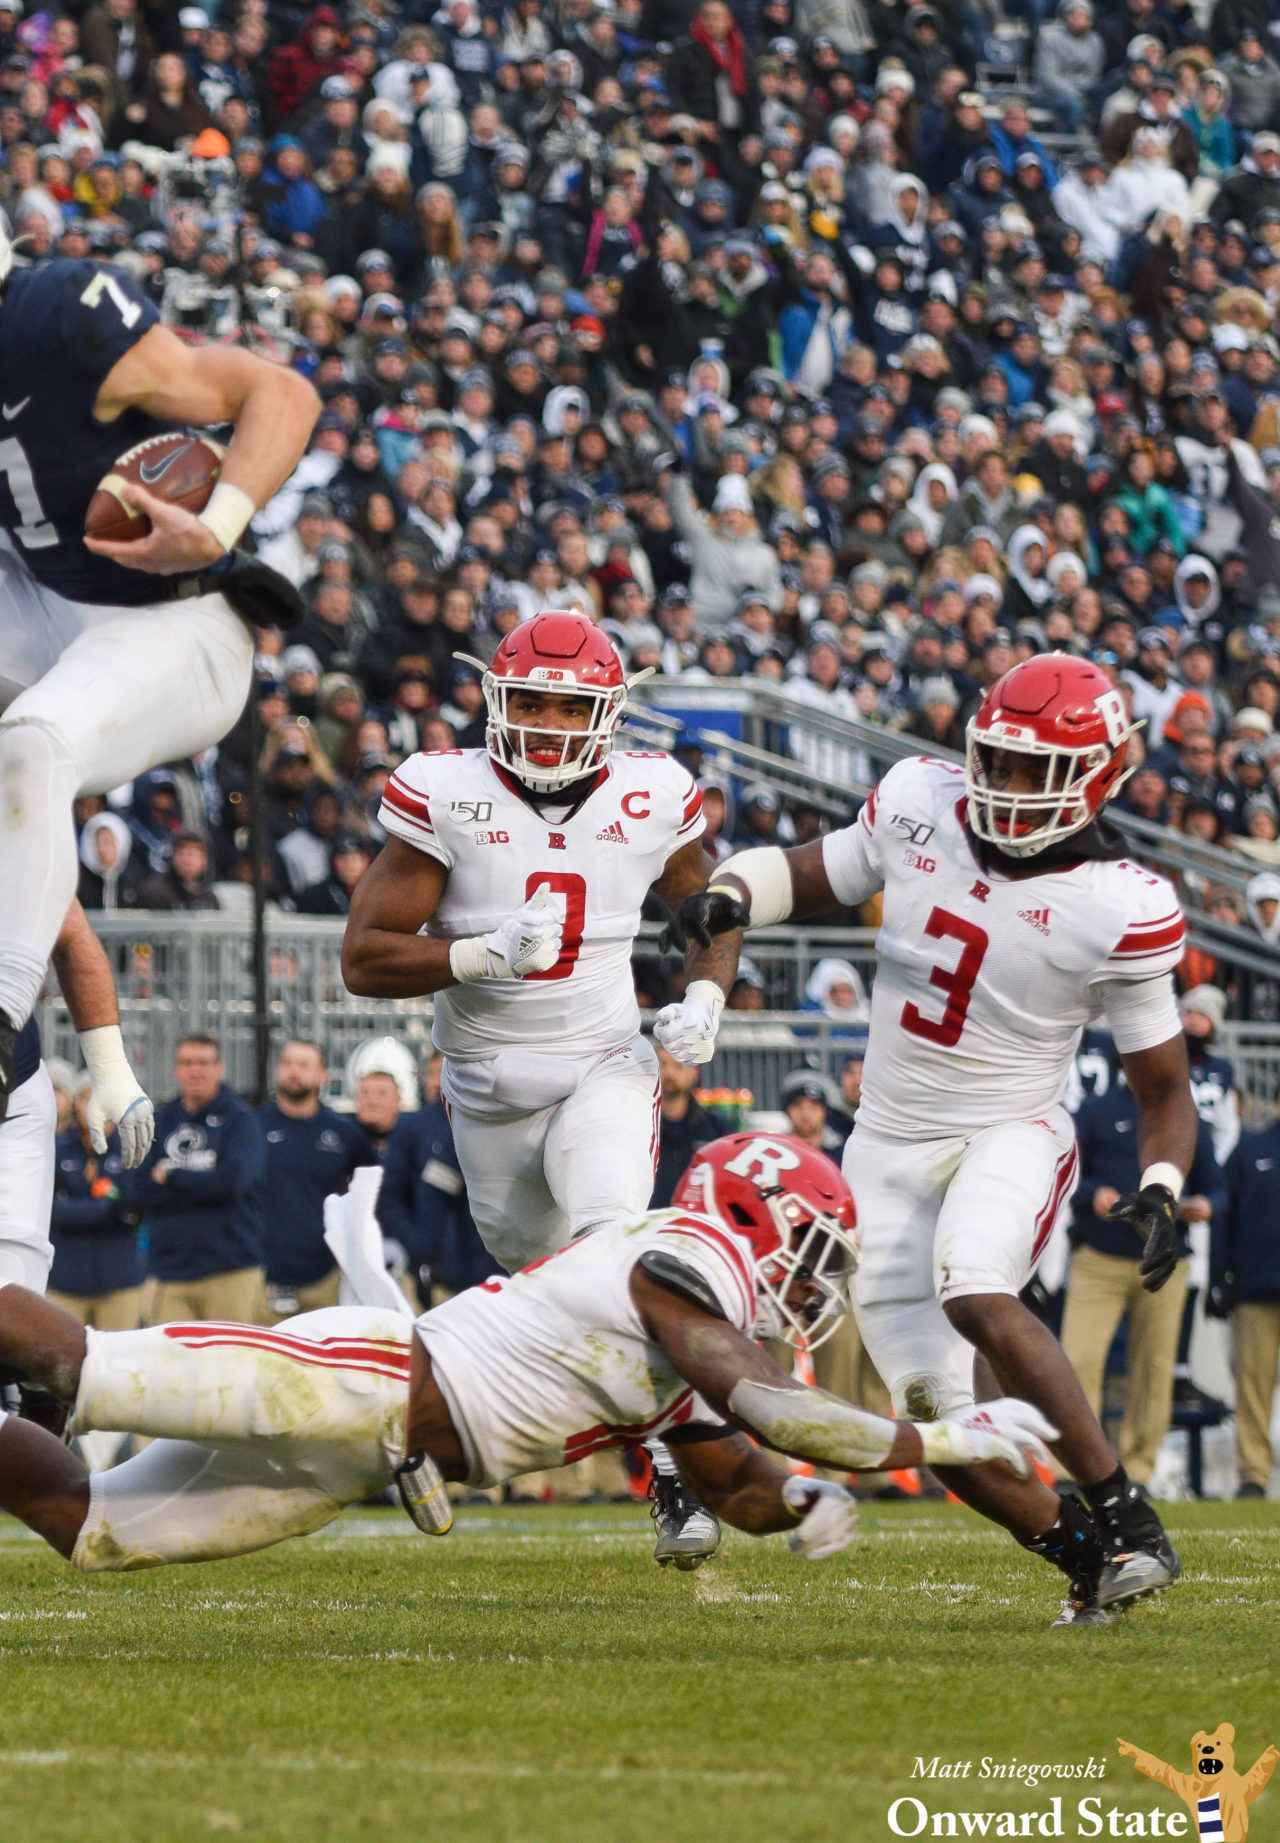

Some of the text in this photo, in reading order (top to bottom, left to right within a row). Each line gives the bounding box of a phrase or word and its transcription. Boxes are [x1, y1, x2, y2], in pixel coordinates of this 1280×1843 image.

[80, 270, 142, 330] 7
[449, 801, 493, 823] 150
[621, 791, 651, 820] C
[548, 832, 567, 850] R
[596, 830, 629, 845] adidas
[888, 814, 936, 849] 150
[969, 879, 991, 904] R
[1016, 909, 1051, 937] adidas
[899, 905, 990, 1048] 3
[723, 1137, 801, 1189] R
